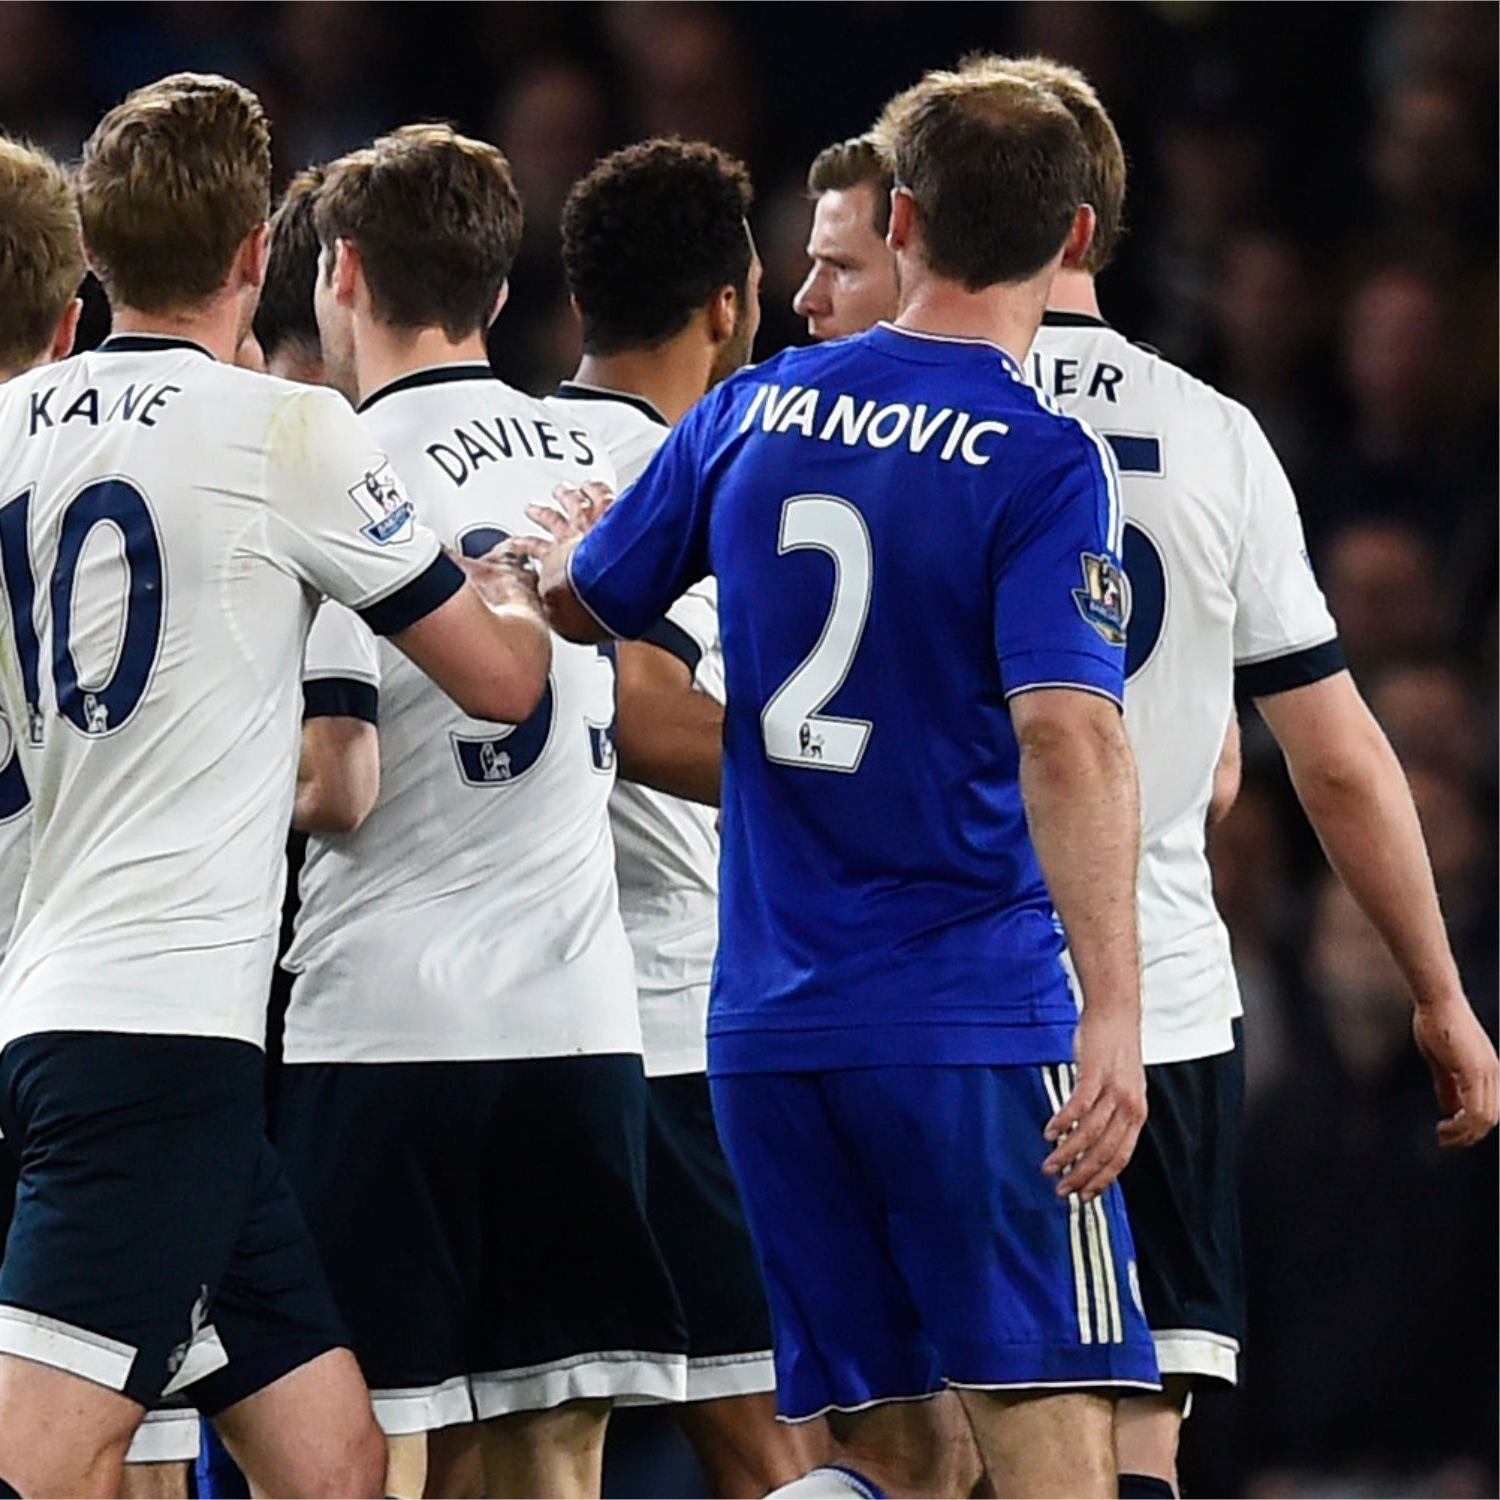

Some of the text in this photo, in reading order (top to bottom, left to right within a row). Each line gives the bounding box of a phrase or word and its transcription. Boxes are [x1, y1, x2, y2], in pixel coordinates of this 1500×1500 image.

[29, 383, 182, 437] KANE
[739, 384, 1010, 466] IVANOVIC
[425, 417, 594, 487] DAVIES
[759, 494, 873, 774] 2
